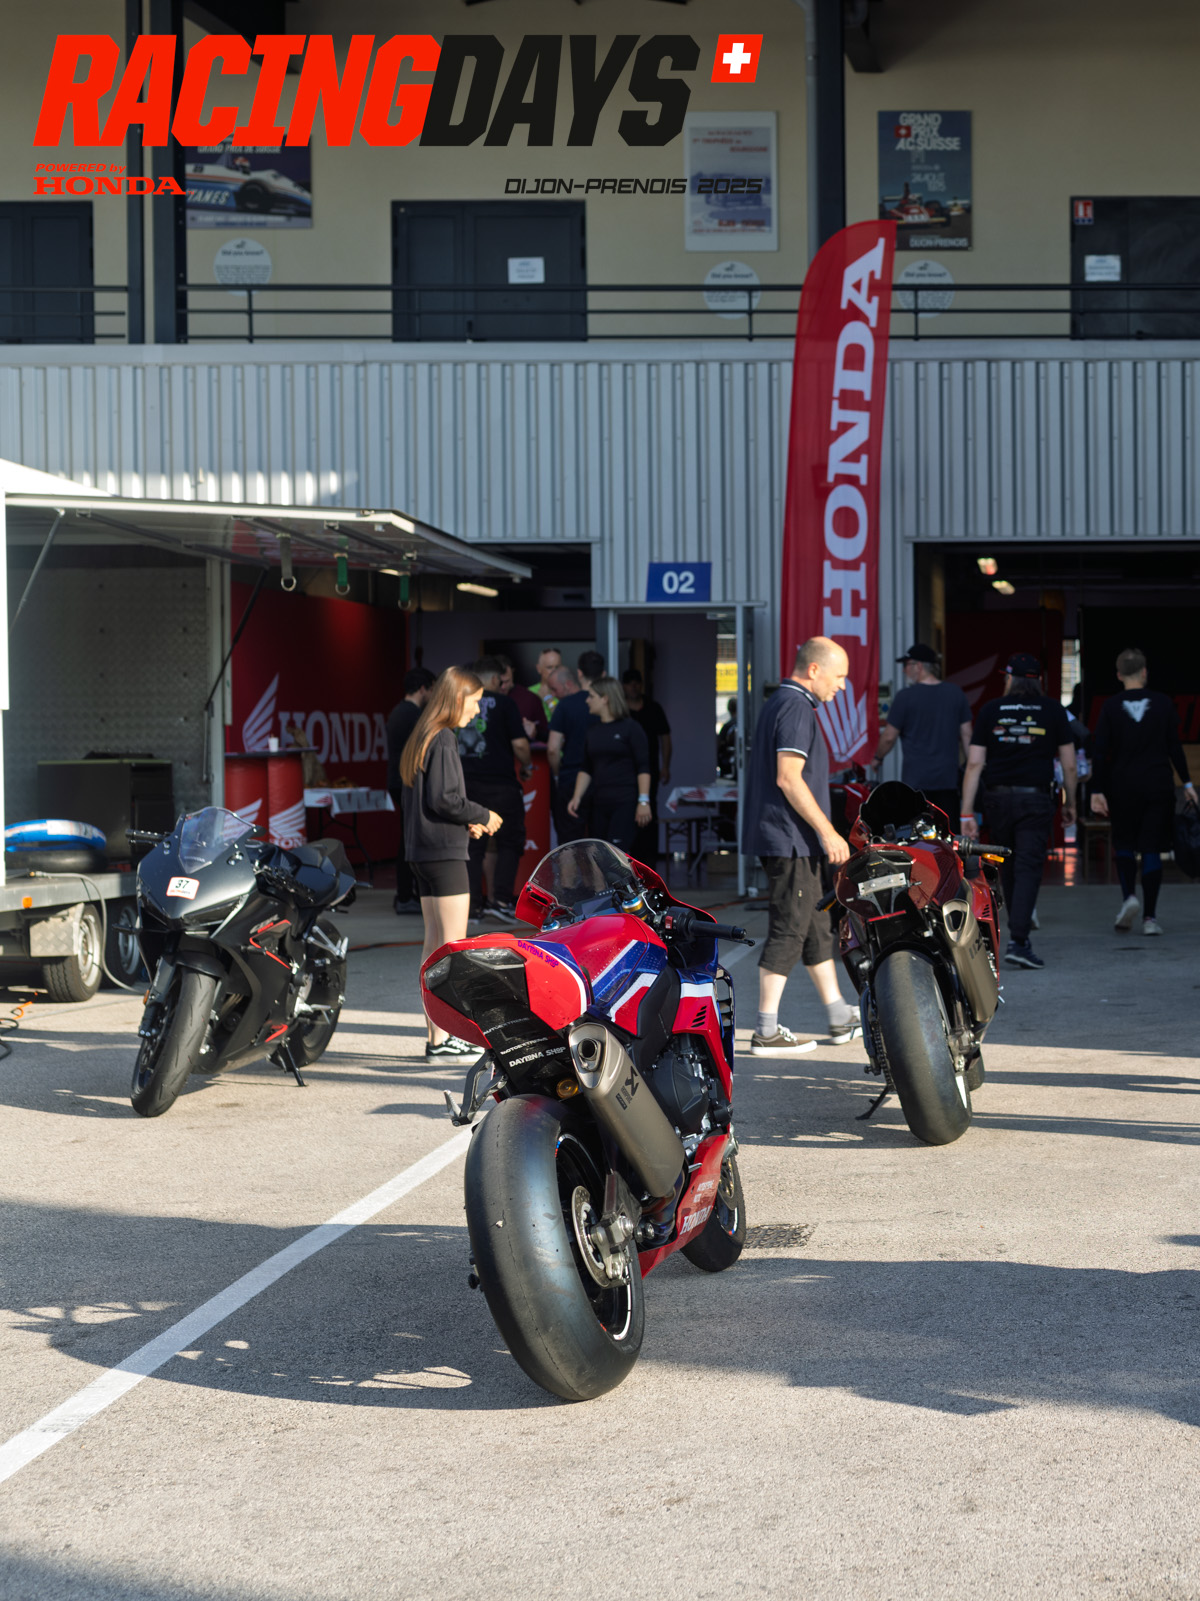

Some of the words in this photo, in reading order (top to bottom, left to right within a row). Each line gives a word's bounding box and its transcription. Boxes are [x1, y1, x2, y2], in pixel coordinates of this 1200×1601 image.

[822, 237, 886, 647] HONDA
[662, 571, 695, 594] 02
[175, 879, 190, 889] 37
[517, 939, 544, 961] DAYTONA
[508, 1051, 545, 1068] DAYTONA
[545, 1046, 567, 1058] SHOP
